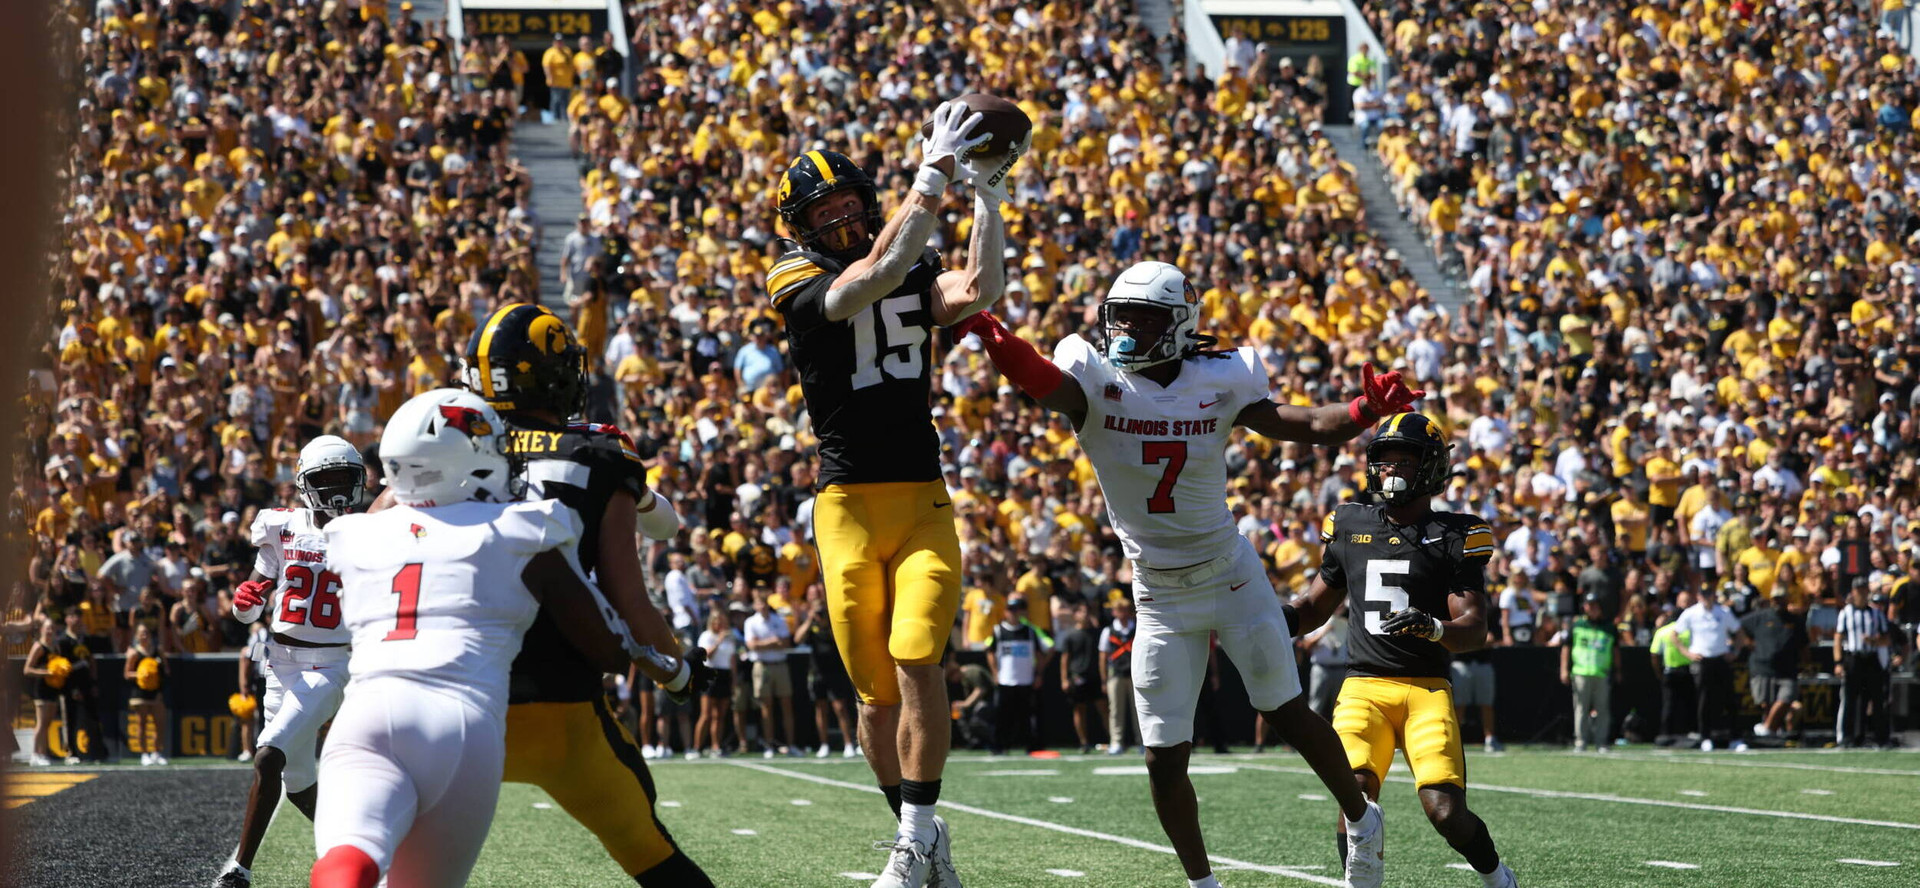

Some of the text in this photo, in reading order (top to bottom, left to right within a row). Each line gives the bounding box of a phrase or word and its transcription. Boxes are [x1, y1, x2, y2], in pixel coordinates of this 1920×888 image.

[478, 13, 591, 35] 123 124
[1288, 20, 1330, 41] 125
[847, 293, 928, 391] 15
[469, 367, 509, 392] 85
[1104, 415, 1217, 436] ILLINOIS STATE
[1142, 441, 1188, 514] 7
[280, 564, 344, 629] 26
[381, 562, 424, 642] 1
[1364, 559, 1410, 635] 5
